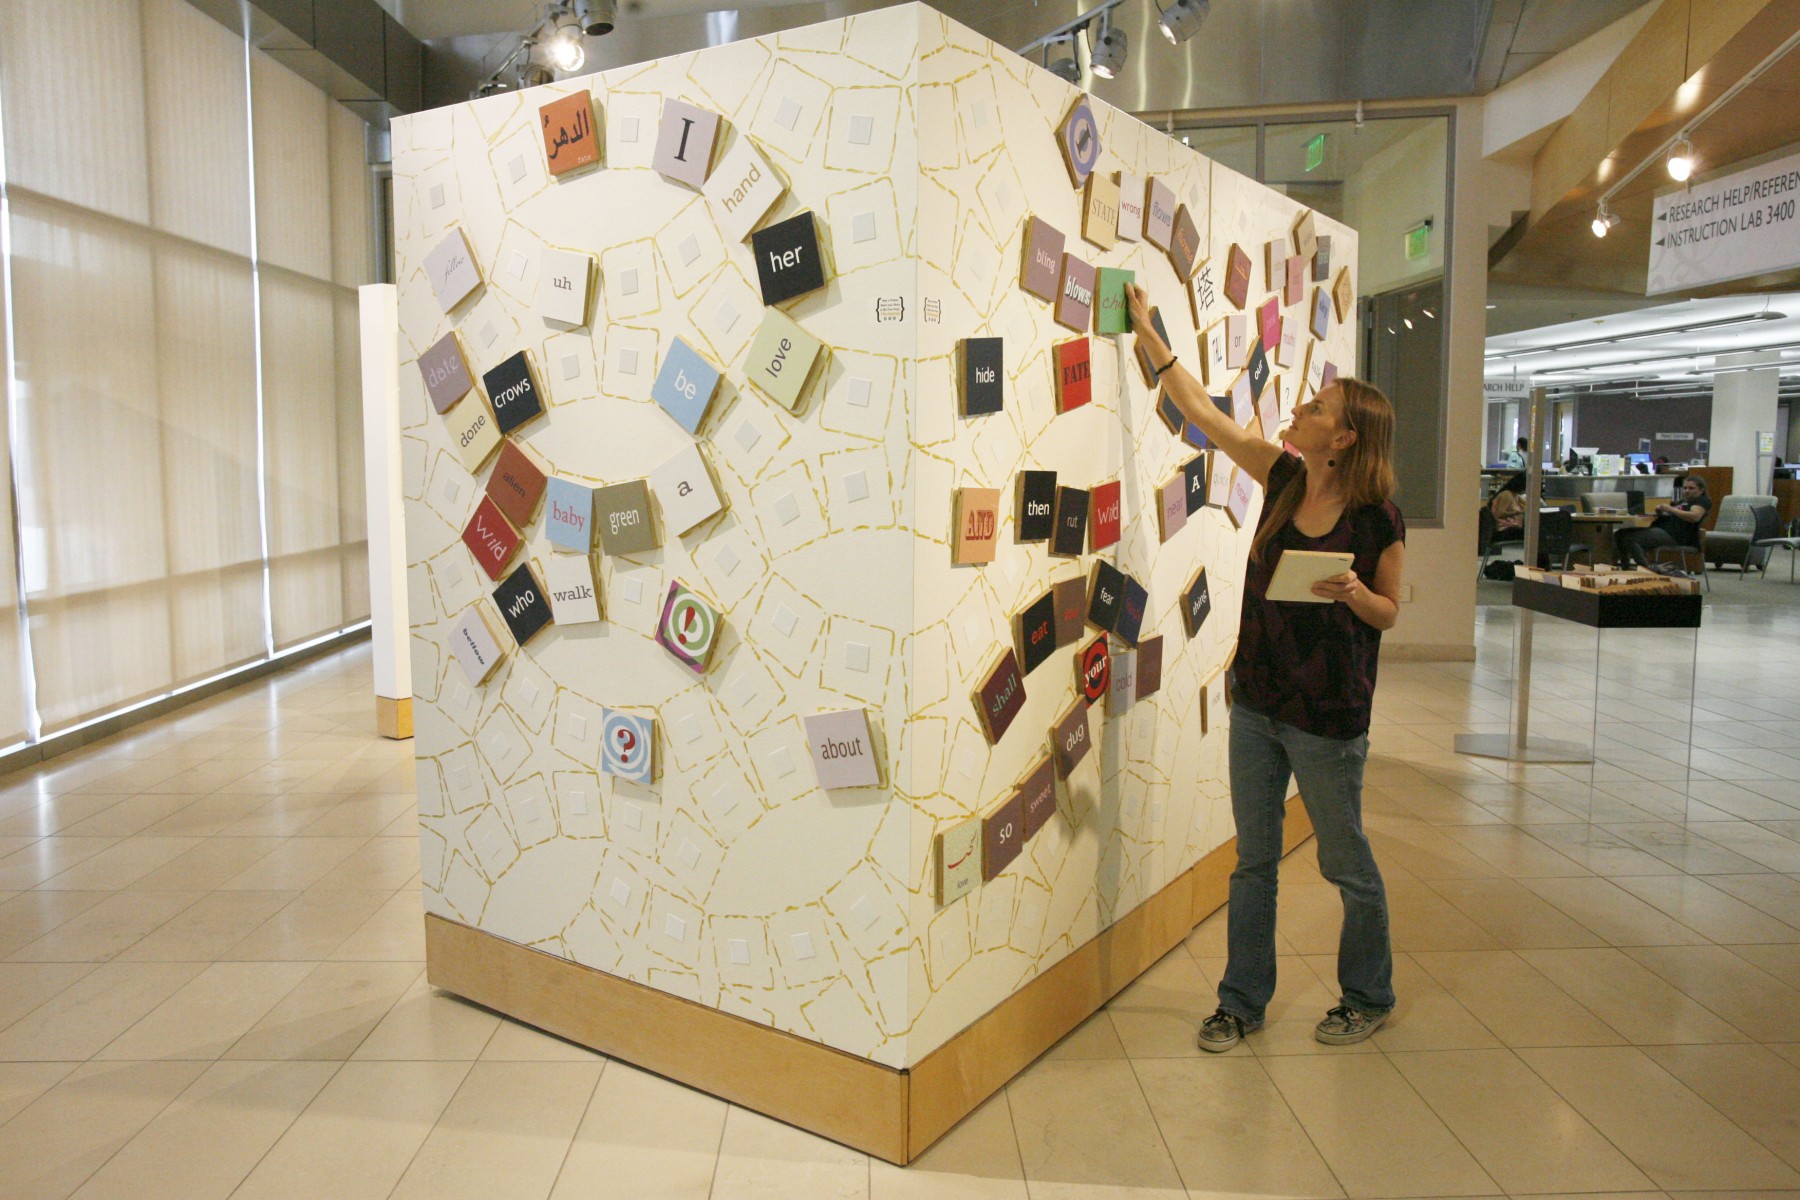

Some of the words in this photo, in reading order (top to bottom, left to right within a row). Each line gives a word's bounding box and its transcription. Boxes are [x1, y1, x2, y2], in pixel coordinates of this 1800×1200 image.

[673, 117, 695, 163] I
[721, 162, 762, 213] hand
[1091, 198, 1116, 226] STATE
[1121, 201, 1141, 219] wrong
[1669, 194, 1720, 223] RESEARCH
[1667, 216, 1738, 249] INSTRUCTION
[1740, 210, 1762, 231] LAB
[1766, 200, 1795, 224] 3400
[769, 244, 803, 274] her
[1036, 247, 1056, 276] bling
[553, 276, 572, 292] uh
[1065, 275, 1092, 308] blows
[1234, 336, 1241, 348] or
[429, 354, 459, 389] date
[765, 337, 792, 379] love
[1254, 360, 1263, 380] our
[673, 369, 697, 400] be
[975, 366, 995, 383] hide
[1063, 361, 1090, 386] FATE
[1505, 383, 1525, 392] HELP
[494, 377, 531, 410] crows
[459, 413, 487, 448] done
[502, 470, 526, 498] alien
[676, 480, 693, 497] a
[1191, 475, 1201, 493] A
[552, 501, 585, 531] baby
[609, 509, 640, 535] green
[1028, 500, 1050, 517] then
[1067, 515, 1078, 528] rut
[1097, 500, 1119, 525] Wild
[1167, 497, 1183, 519] near
[475, 514, 507, 561] Wild
[965, 510, 994, 540] AND
[508, 590, 535, 619] who
[553, 585, 593, 603] walk
[1100, 587, 1114, 605] fear
[1031, 620, 1048, 645] eat
[462, 628, 486, 666] bellow
[1084, 655, 1107, 687] your
[1115, 674, 1132, 692] cold
[993, 673, 1017, 717] shall
[821, 735, 864, 760] about
[1066, 722, 1085, 752] dug
[1029, 784, 1052, 813] sweet
